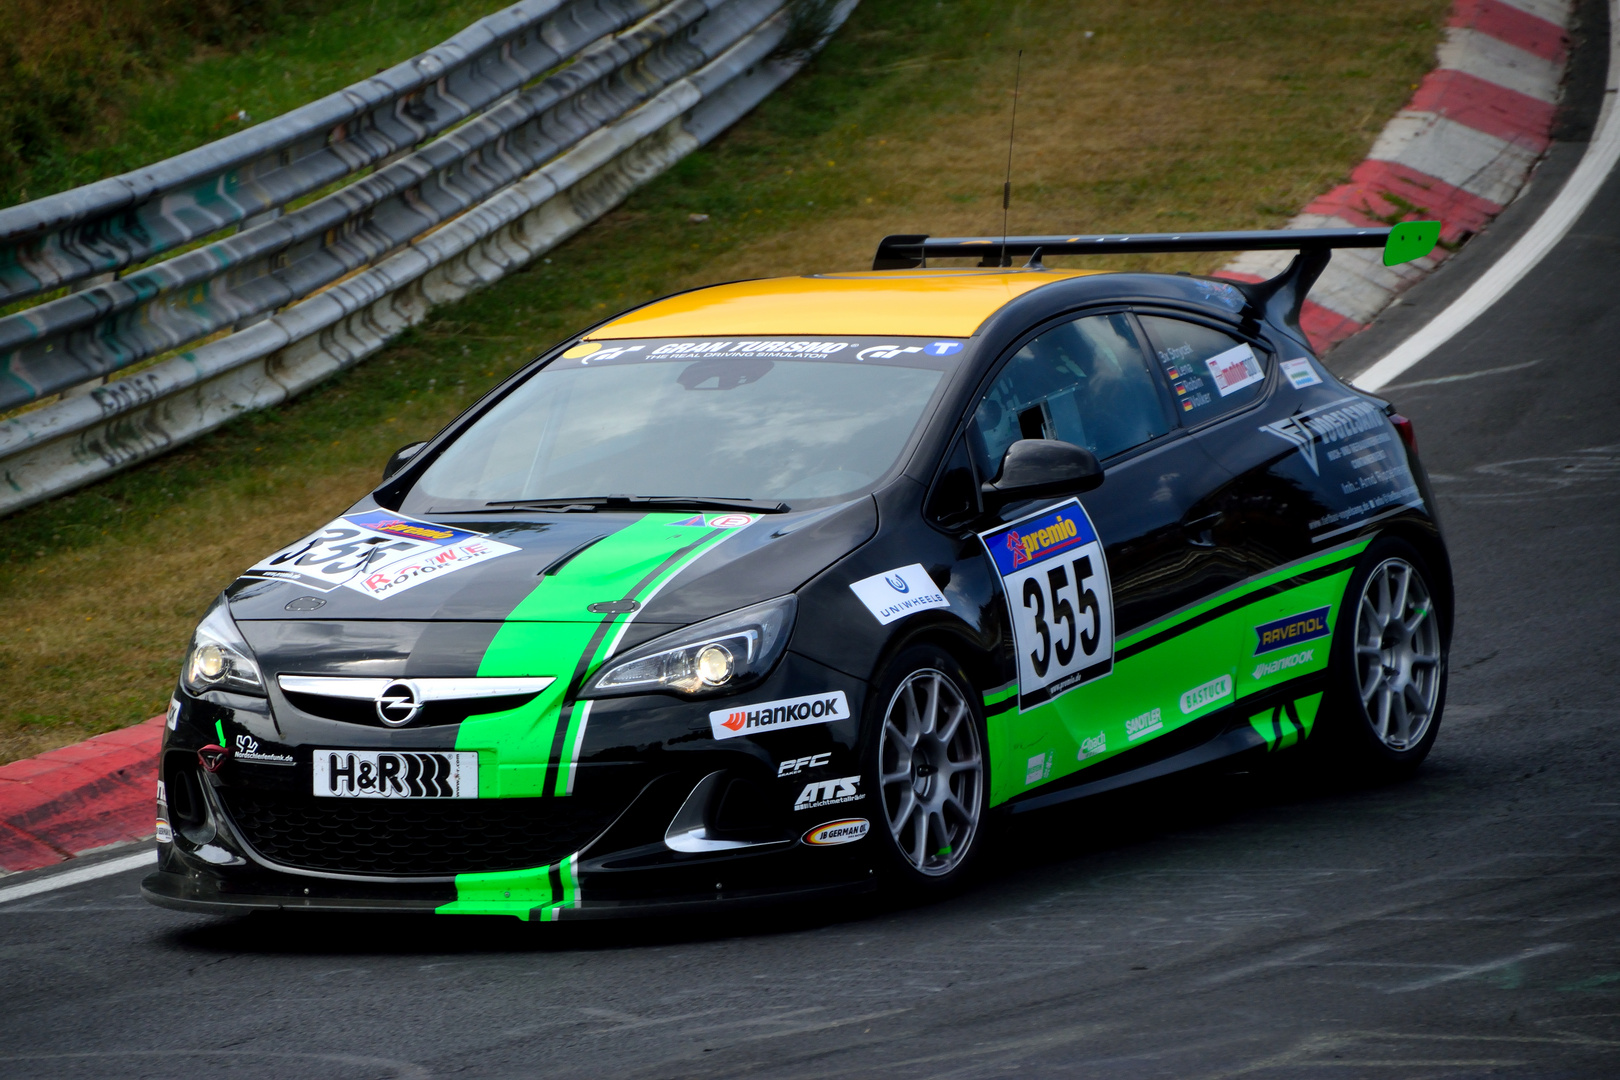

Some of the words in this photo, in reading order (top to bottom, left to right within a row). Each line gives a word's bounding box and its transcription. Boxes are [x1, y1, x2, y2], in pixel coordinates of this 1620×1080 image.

[651, 341, 733, 355] GRAN
[728, 341, 849, 354] TURISMO
[755, 351, 829, 359] SIMULATOR
[1021, 515, 1077, 561] premio
[374, 562, 451, 594] MOTOR
[880, 594, 944, 618] UNIWHEELS
[1023, 554, 1101, 678] 355
[1262, 617, 1324, 646] RAVENOL
[1186, 679, 1226, 709] BASTUCK
[1125, 707, 1162, 735] SANDTLER
[328, 752, 454, 797] H&R
[778, 752, 832, 774] PFC
[794, 775, 862, 806] ATS
[820, 830, 828, 841] JB
[829, 826, 859, 838] GERMAN
